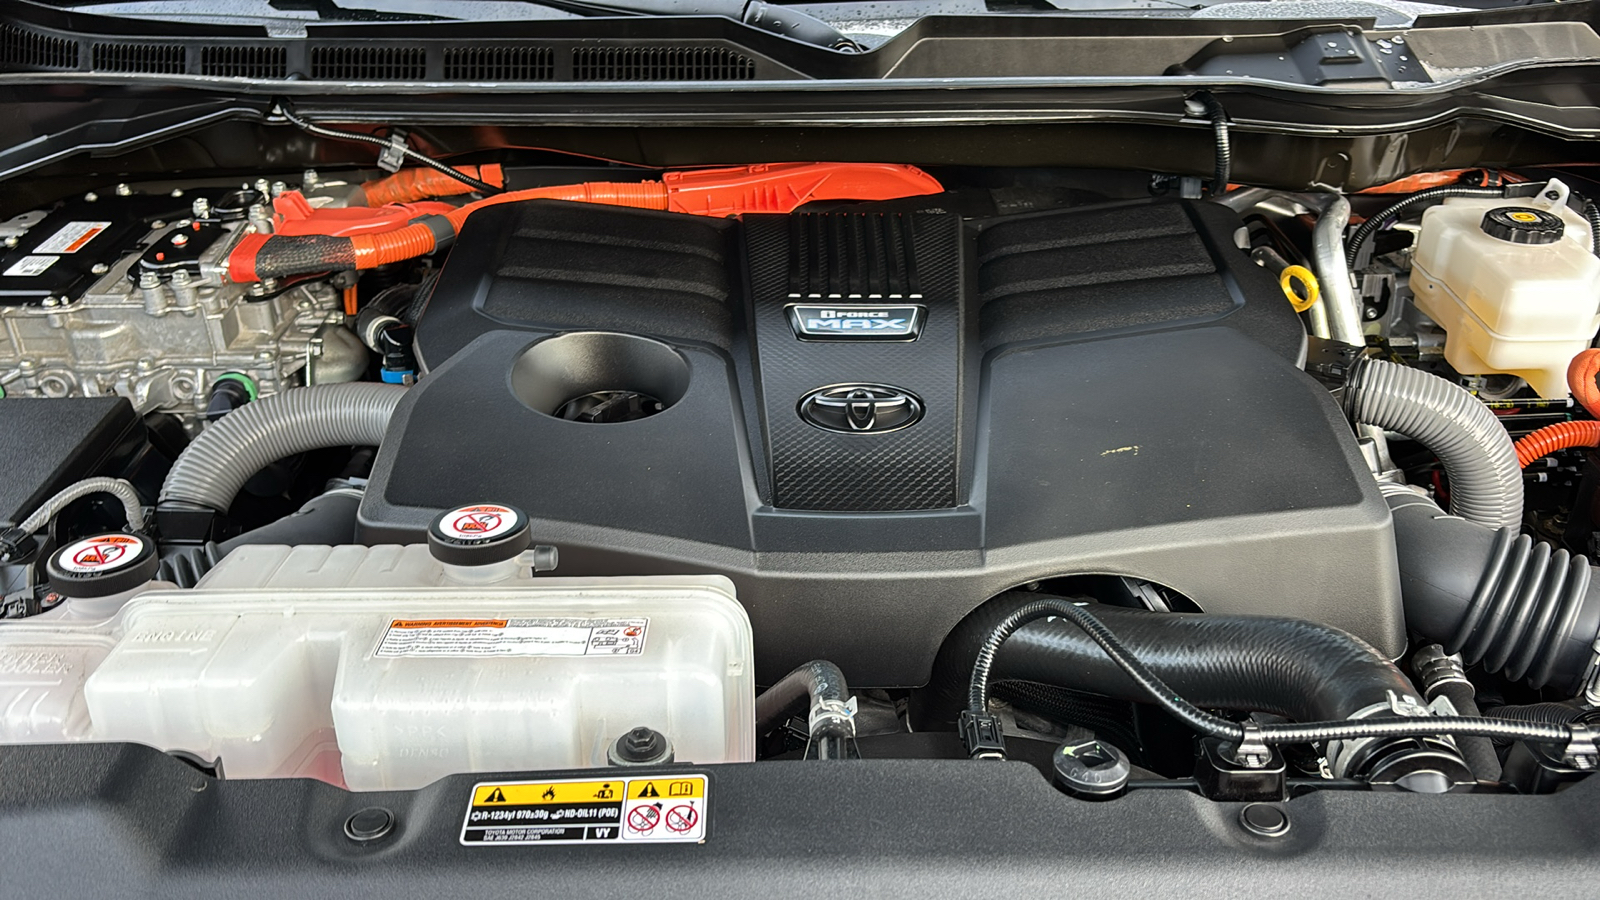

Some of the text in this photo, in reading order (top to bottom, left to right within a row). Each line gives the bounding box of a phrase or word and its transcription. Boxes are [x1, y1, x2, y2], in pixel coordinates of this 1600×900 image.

[807, 318, 906, 329] MAX
[131, 630, 216, 642] ENGINE
[597, 807, 619, 818] (POE)
[595, 828, 611, 838] VY
